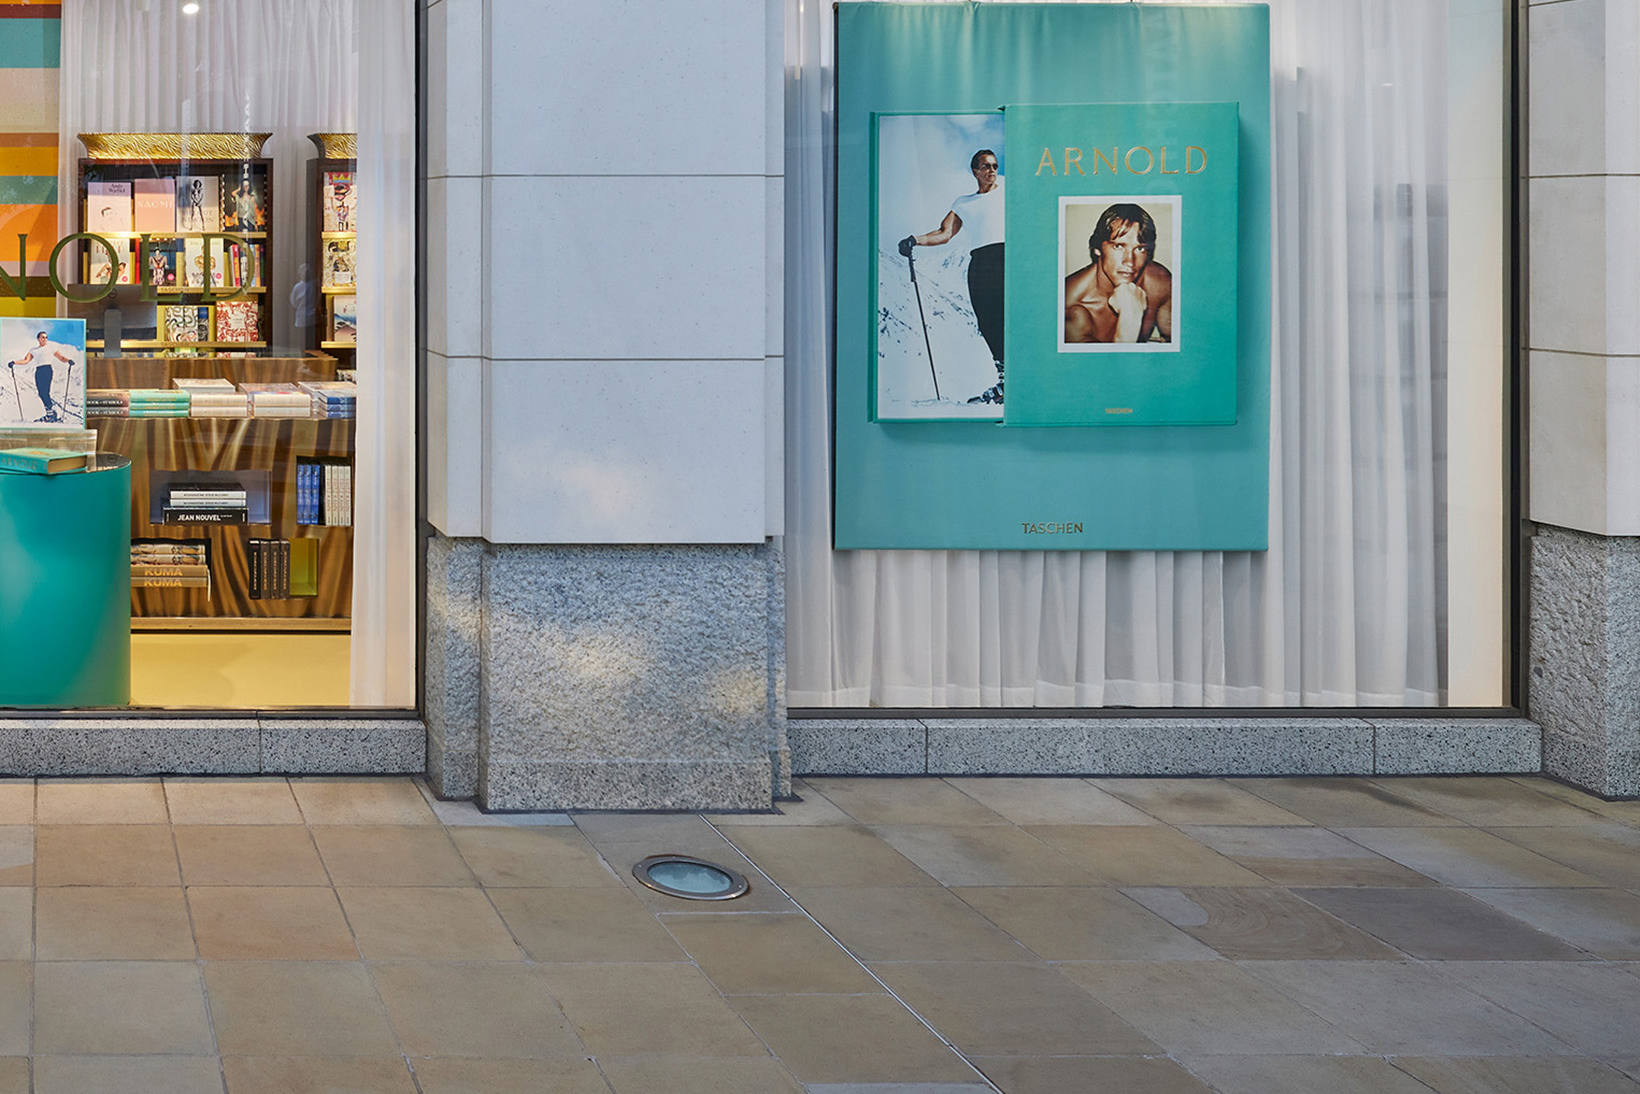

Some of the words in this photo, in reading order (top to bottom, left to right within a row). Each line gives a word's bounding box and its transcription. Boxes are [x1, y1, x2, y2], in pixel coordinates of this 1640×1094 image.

[1035, 145, 1208, 177] ARNOLD
[137, 200, 173, 208] NAOMI
[1, 457, 37, 470] ARNOLD
[1022, 521, 1084, 534] TASCHEN
[144, 568, 183, 576] KUMA
[144, 578, 182, 586] KUMA
